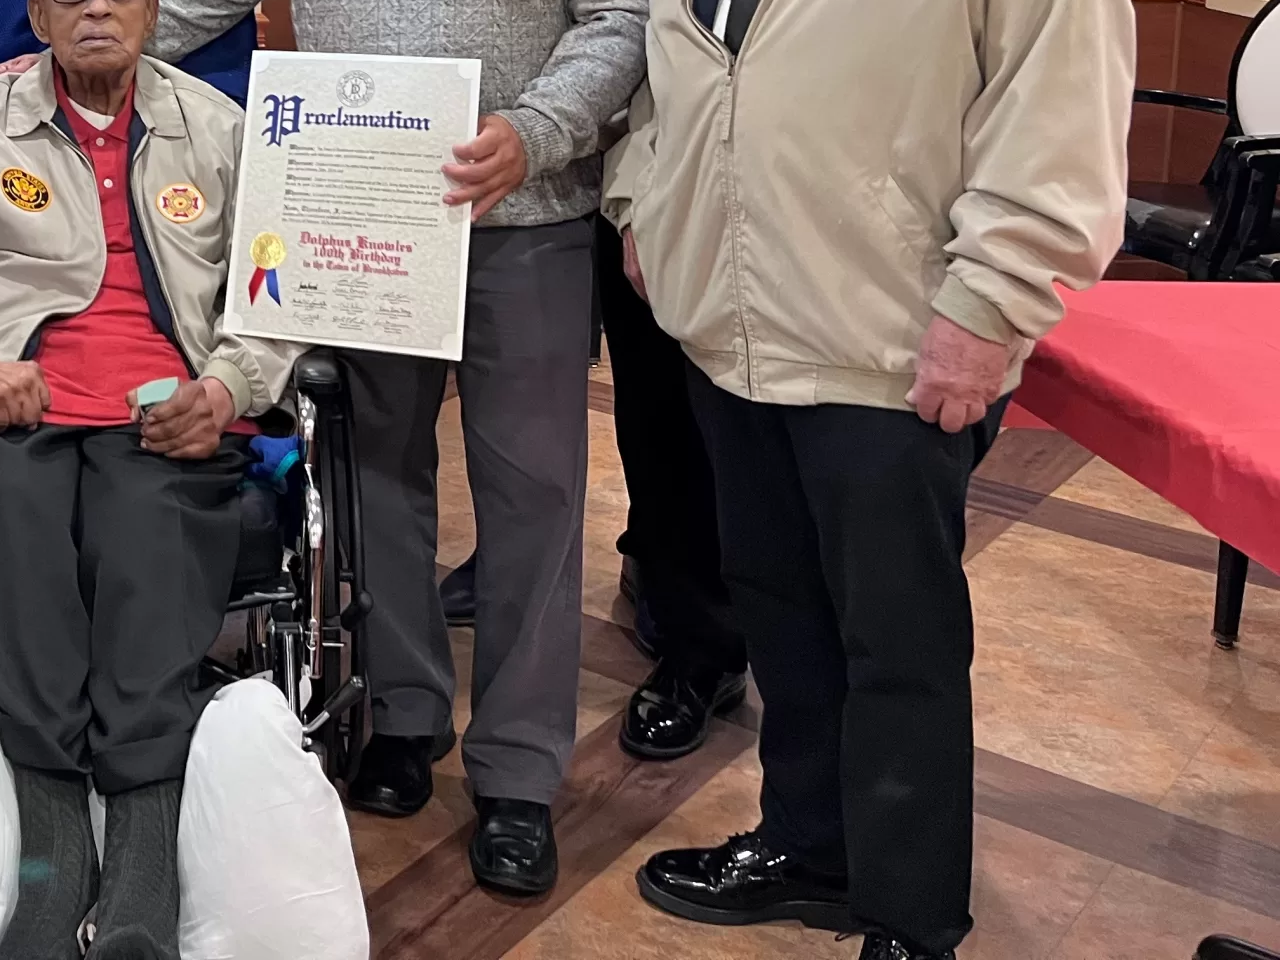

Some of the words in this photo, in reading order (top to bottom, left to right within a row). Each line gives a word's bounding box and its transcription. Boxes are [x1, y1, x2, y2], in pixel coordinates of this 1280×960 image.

[261, 94, 431, 147] Proclamation
[298, 231, 351, 248] Dolphus
[314, 246, 345, 261] 100th
[349, 248, 401, 266] Birthday
[326, 260, 349, 271] Town
[351, 263, 359, 272] of
